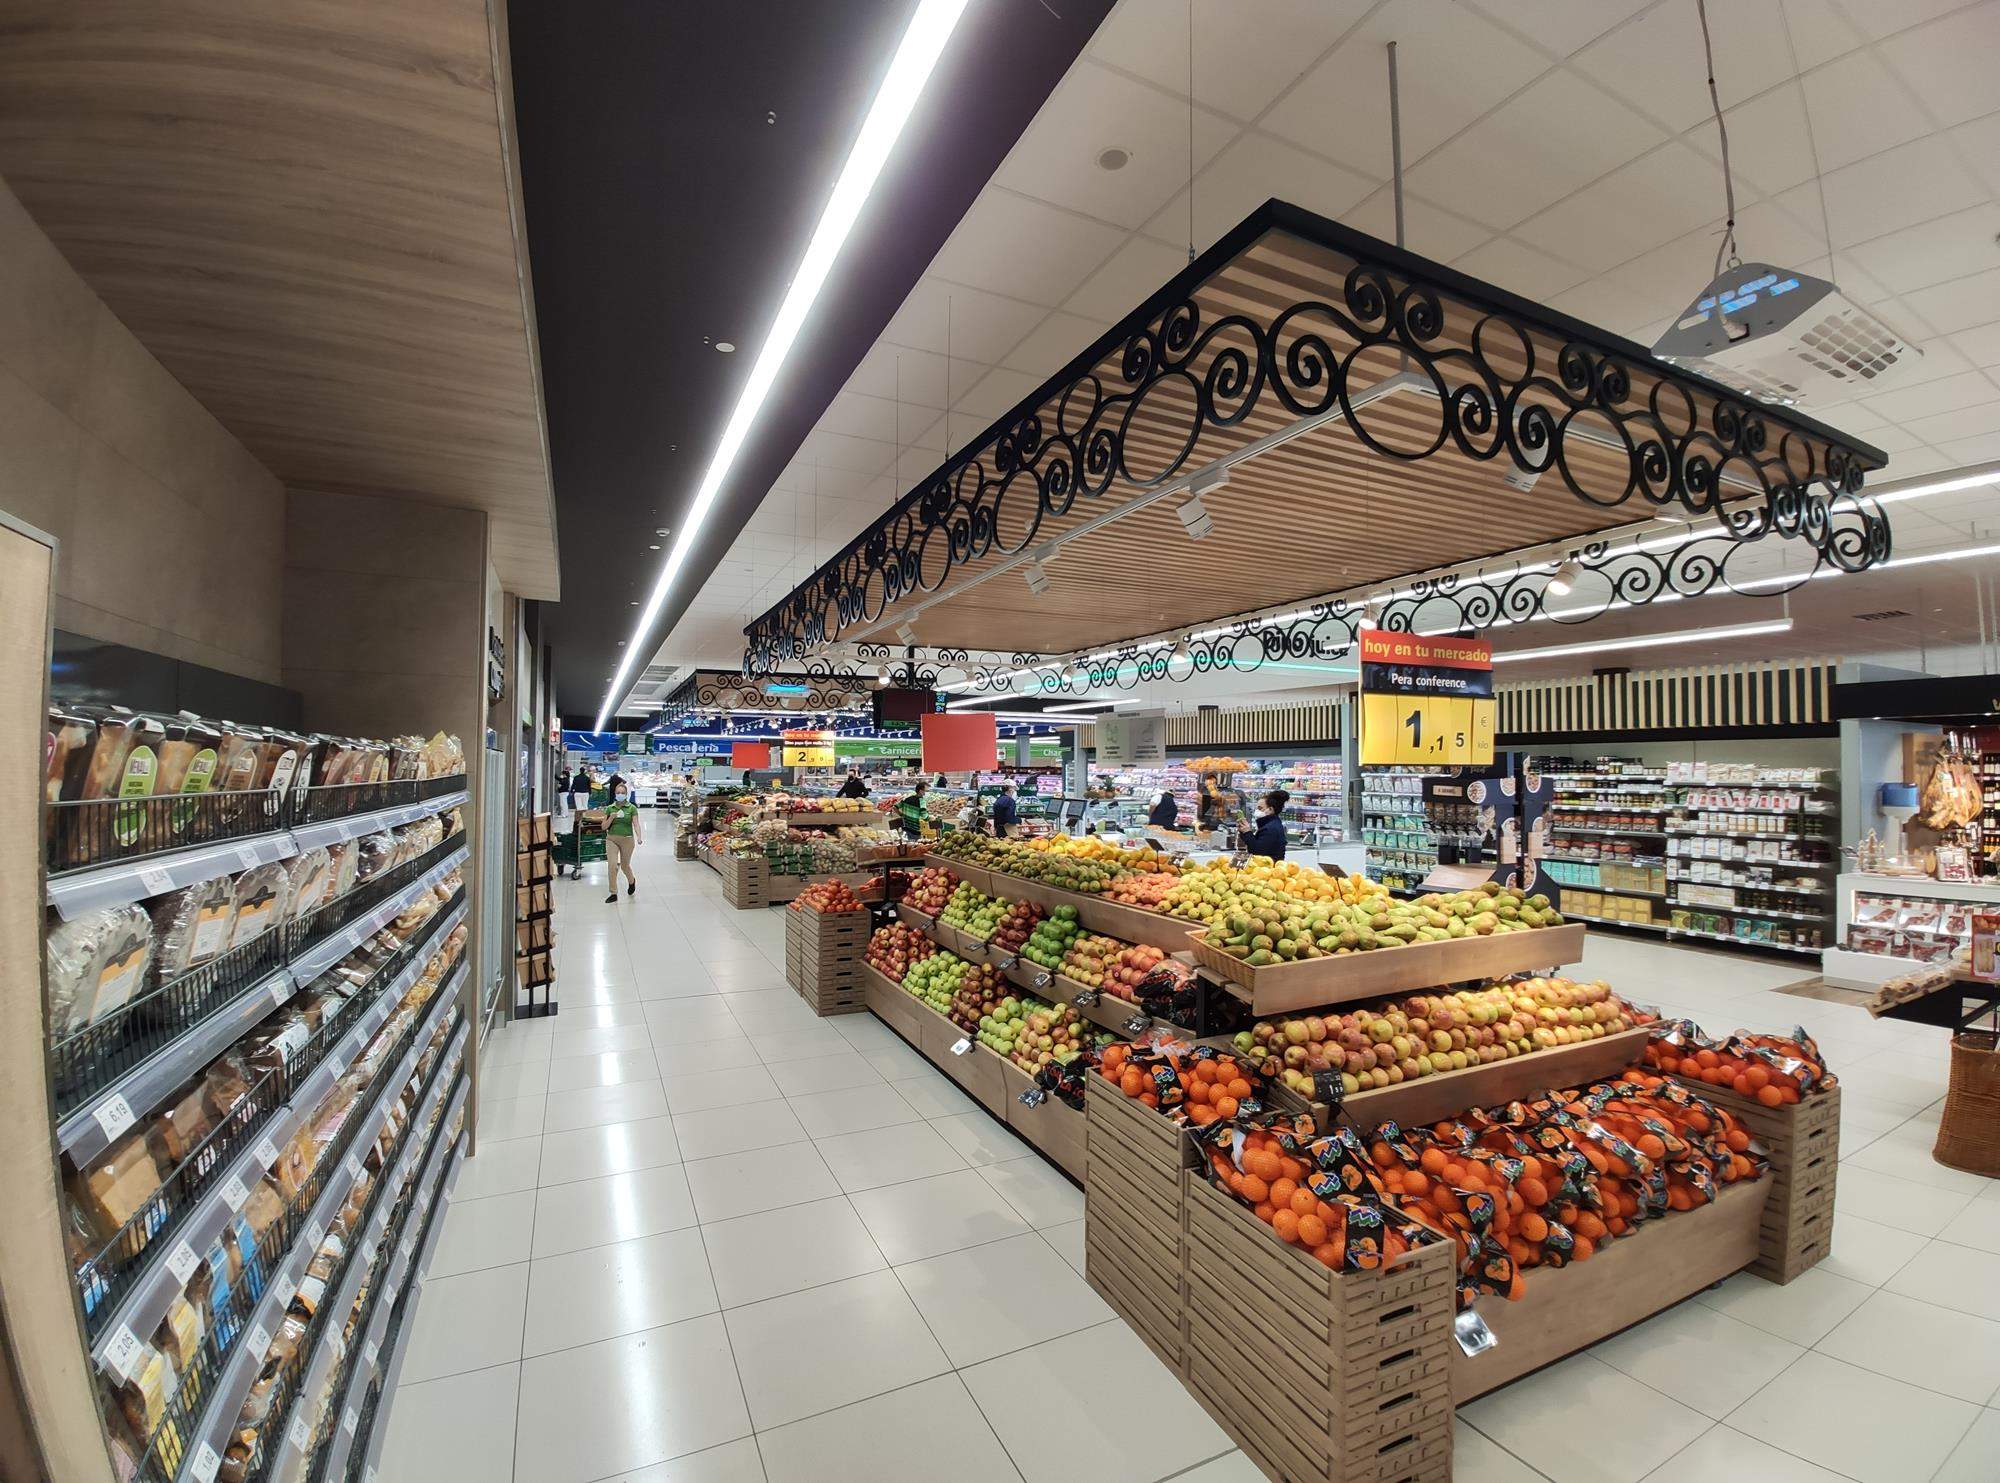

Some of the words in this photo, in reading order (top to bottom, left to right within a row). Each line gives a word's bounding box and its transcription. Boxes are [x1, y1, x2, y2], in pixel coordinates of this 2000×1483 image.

[1364, 638, 1391, 657] hoy
[1394, 644, 1412, 656] en
[1415, 644, 1429, 657] tu
[1433, 648, 1489, 662] mercado
[1391, 673, 1413, 685] Pera
[1415, 675, 1467, 689] conference
